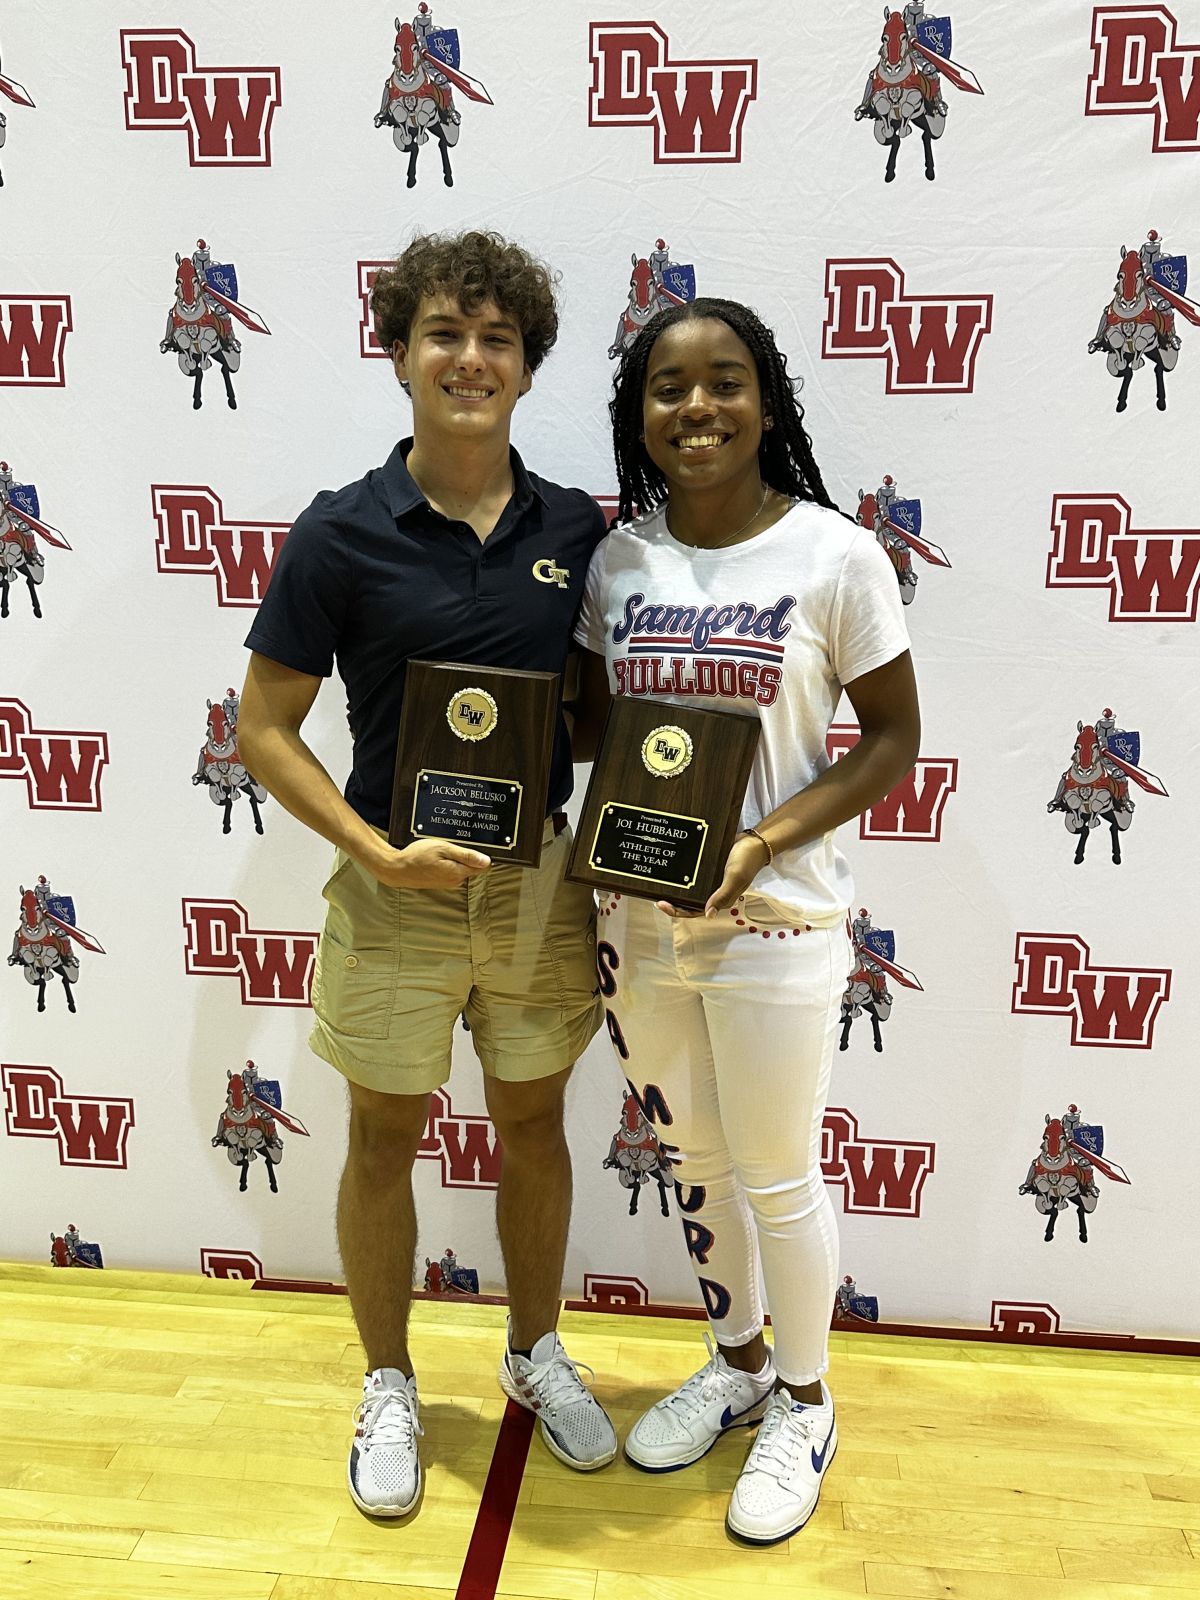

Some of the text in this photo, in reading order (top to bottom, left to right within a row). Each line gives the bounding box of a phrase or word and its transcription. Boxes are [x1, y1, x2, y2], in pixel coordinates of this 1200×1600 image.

[120, 29, 281, 167] DW
[589, 21, 758, 164] DW
[0, 295, 73, 387] W
[821, 257, 993, 394] DW
[151, 484, 295, 607] DW
[1045, 493, 1200, 622] DW
[532, 558, 570, 589] GT
[612, 592, 797, 652] Samford
[613, 656, 784, 707] BULLDOGS
[459, 702, 486, 727] DW
[430, 785, 506, 802] JACKSON BELUSKO
[478, 812, 498, 821] WEBB
[430, 816, 500, 832] MEMORIAL AWARD
[456, 830, 472, 838] 2024
[616, 818, 688, 839] JOI HUBBARD
[619, 841, 676, 858] ATHLETE OF
[622, 852, 668, 867] THE YEAR
[633, 864, 652, 874] 2024
[181, 897, 320, 1007] DW
[1011, 932, 1172, 1049] DW
[1, 1064, 135, 1170] DW
